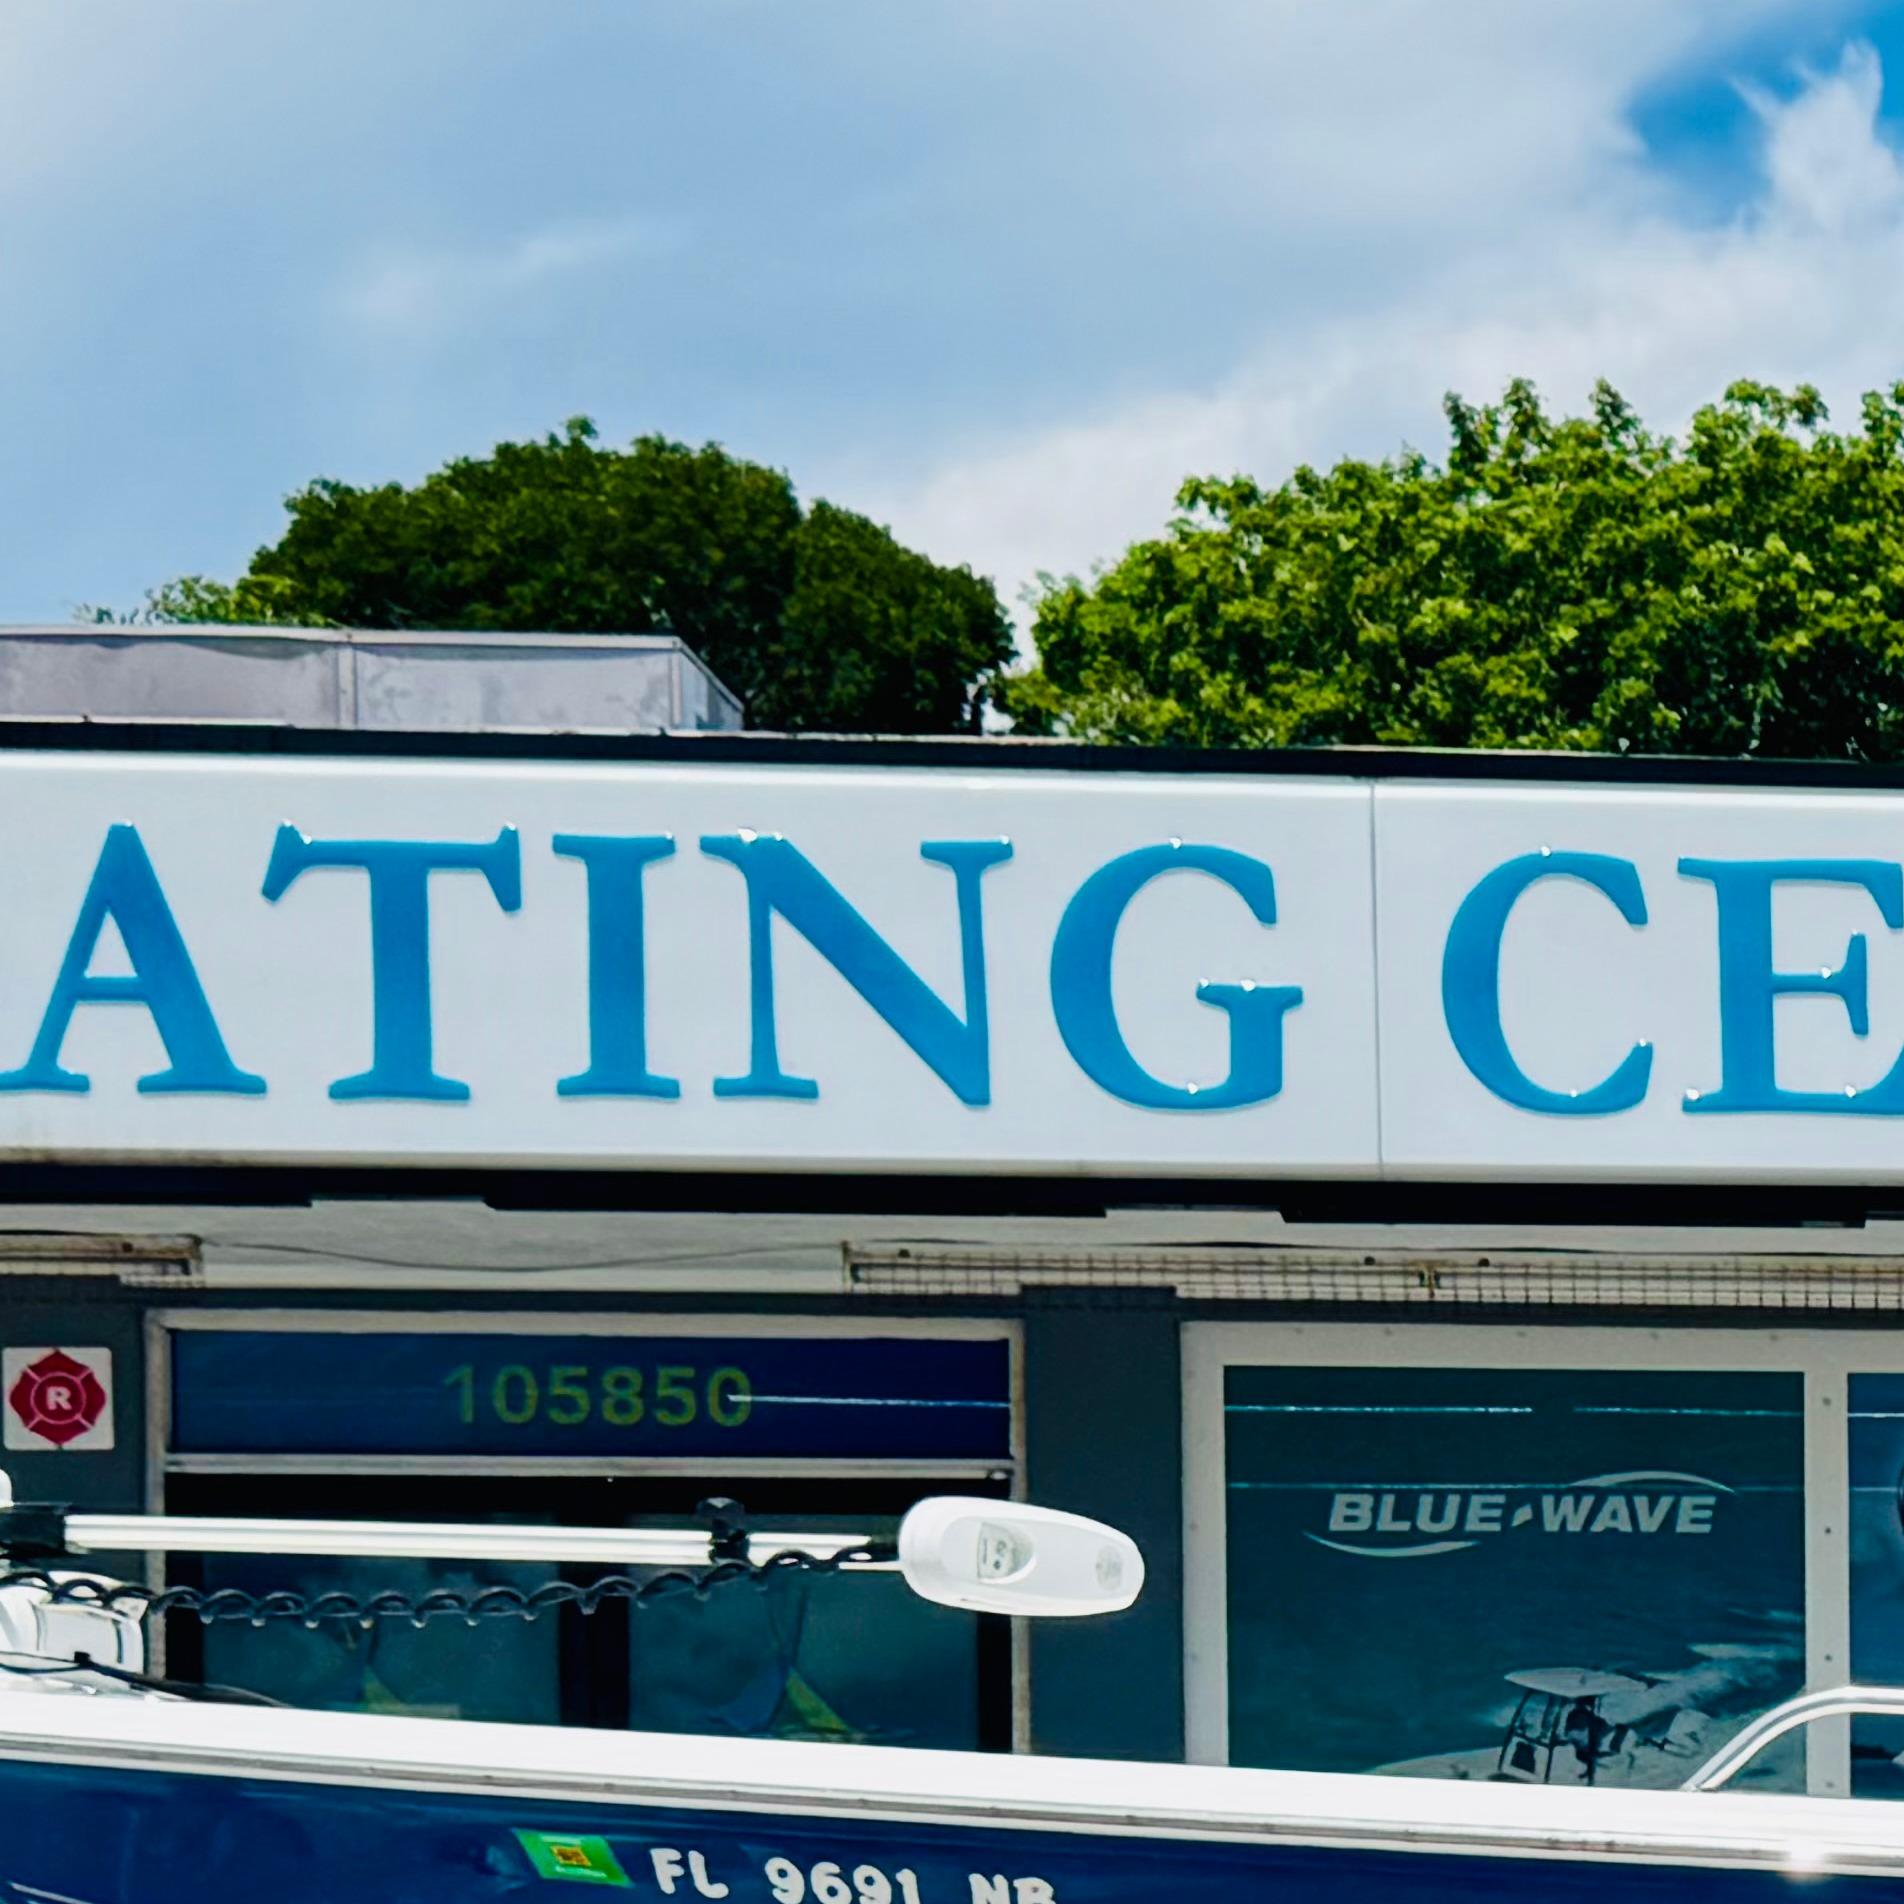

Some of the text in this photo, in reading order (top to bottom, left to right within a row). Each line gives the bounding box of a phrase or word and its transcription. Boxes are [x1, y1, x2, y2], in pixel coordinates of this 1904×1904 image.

[0, 824, 1303, 1114] ATING
[45, 1386, 72, 1411] R
[442, 1364, 753, 1428] 105850
[1329, 1493, 1717, 1534] BLUE WAVE
[650, 1847, 729, 1899] FL
